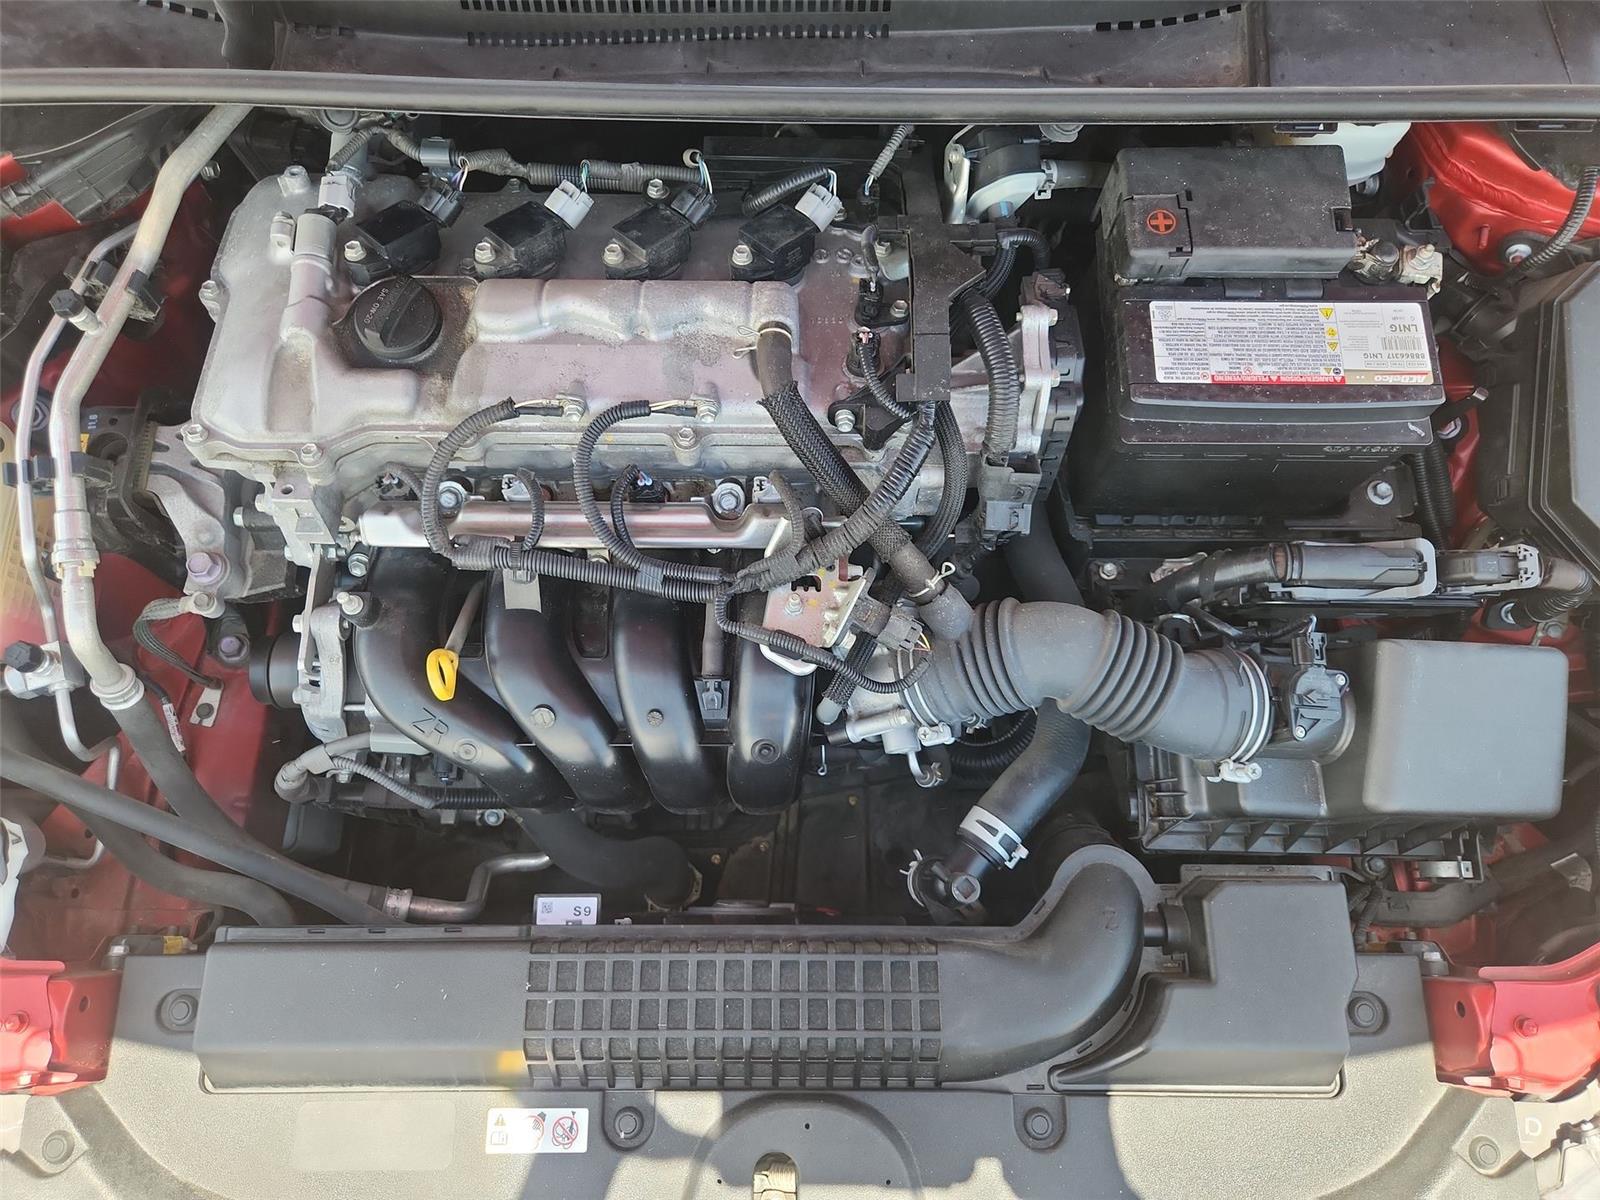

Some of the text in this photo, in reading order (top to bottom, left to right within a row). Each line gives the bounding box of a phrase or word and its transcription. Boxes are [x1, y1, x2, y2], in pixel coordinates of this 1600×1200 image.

[363, 287, 390, 324] SAE 0W-20
[1389, 323, 1418, 333] LN1G
[1363, 352, 1383, 360] LN1G
[1374, 375, 1427, 383] ACDelco
[1524, 1116, 1542, 1137] D
